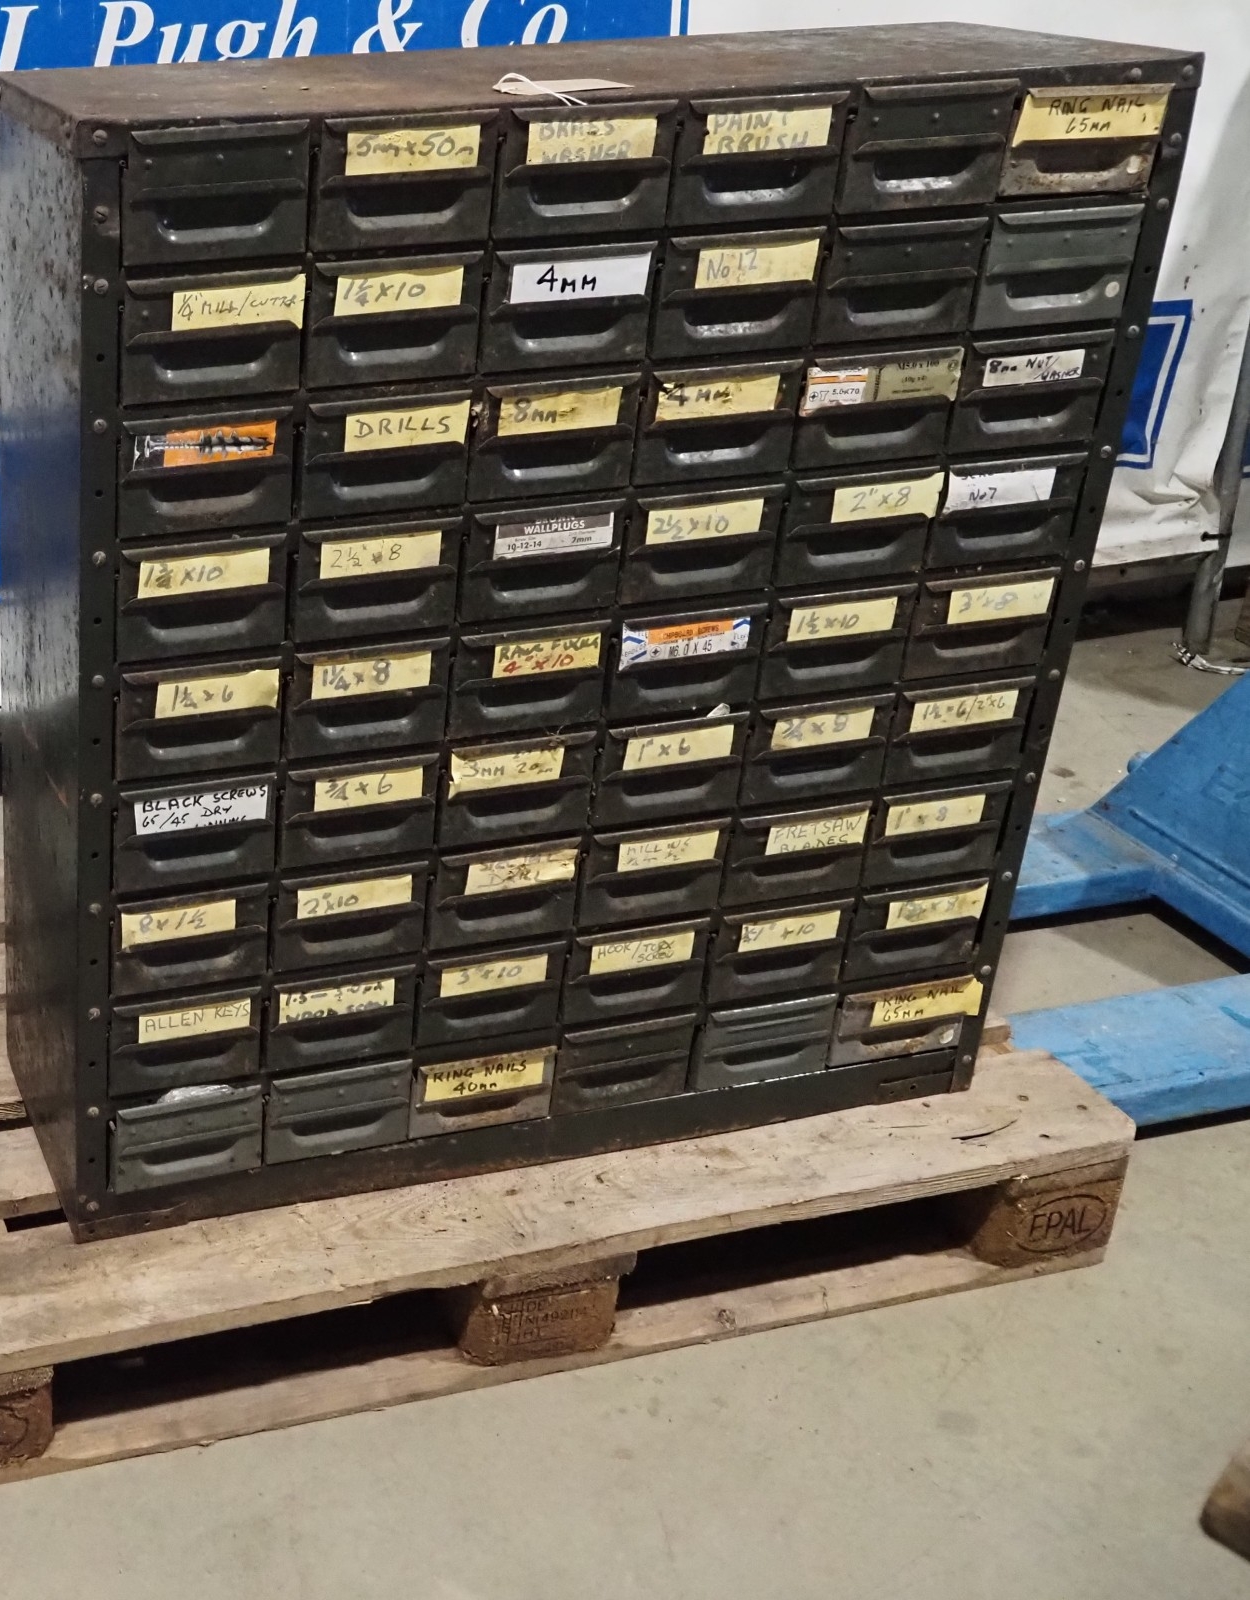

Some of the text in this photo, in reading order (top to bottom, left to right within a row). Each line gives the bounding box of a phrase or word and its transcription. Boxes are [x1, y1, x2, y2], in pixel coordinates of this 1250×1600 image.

[355, 415, 451, 439] DRILLS
[524, 519, 586, 535] WALLPLUGS
[372, 658, 392, 686] 8
[221, 684, 234, 703] 6
[142, 785, 267, 813] BLACK SCREWS
[200, 805, 232, 817] DRY
[773, 815, 863, 844] FRETSAW
[144, 1001, 250, 1033] ALLEN KEYS
[433, 1059, 527, 1083] RING NAILS
[1028, 1206, 1091, 1242] EPAL
